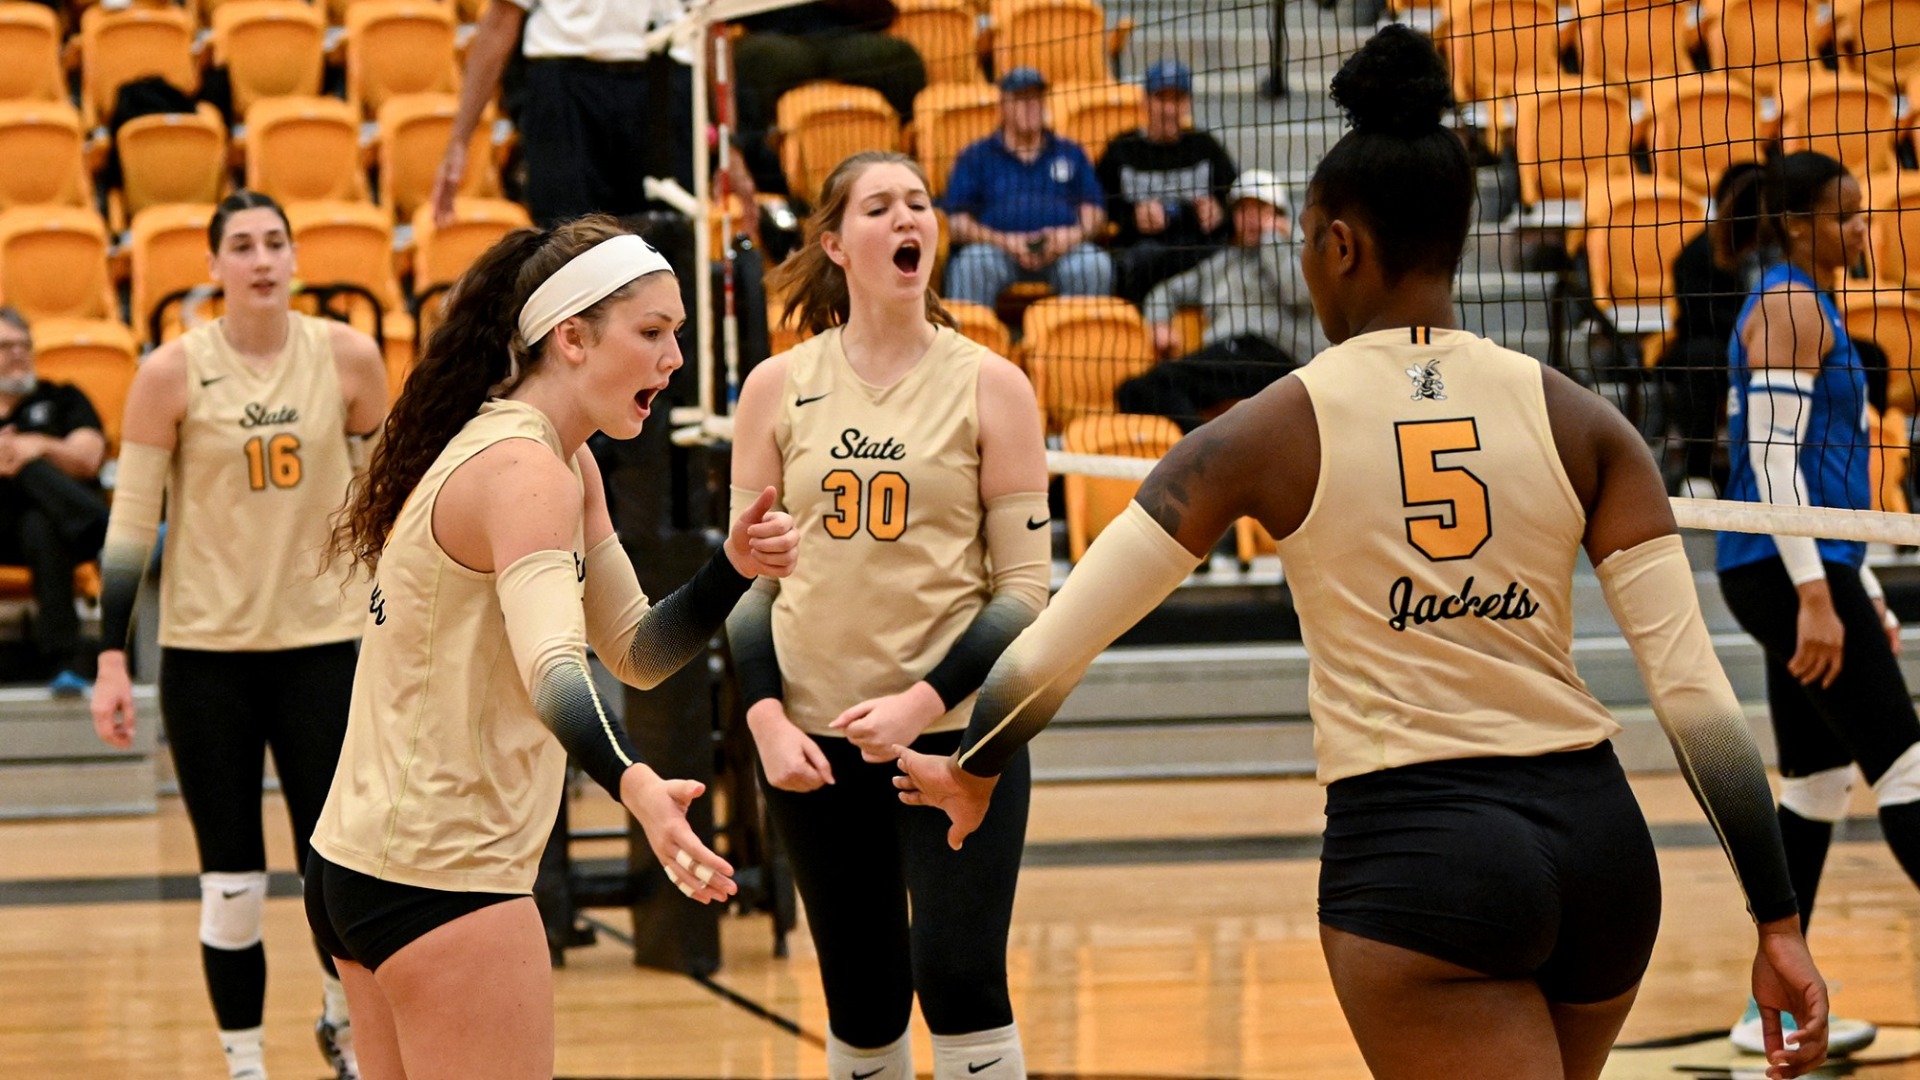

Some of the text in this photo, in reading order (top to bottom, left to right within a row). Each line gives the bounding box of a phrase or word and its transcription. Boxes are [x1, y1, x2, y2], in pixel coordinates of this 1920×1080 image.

[239, 402, 299, 428] State
[830, 427, 906, 460] State
[243, 433, 303, 491] 16
[1393, 416, 1492, 562] 5
[821, 469, 910, 542] 30
[1389, 576, 1539, 632] Jackets
